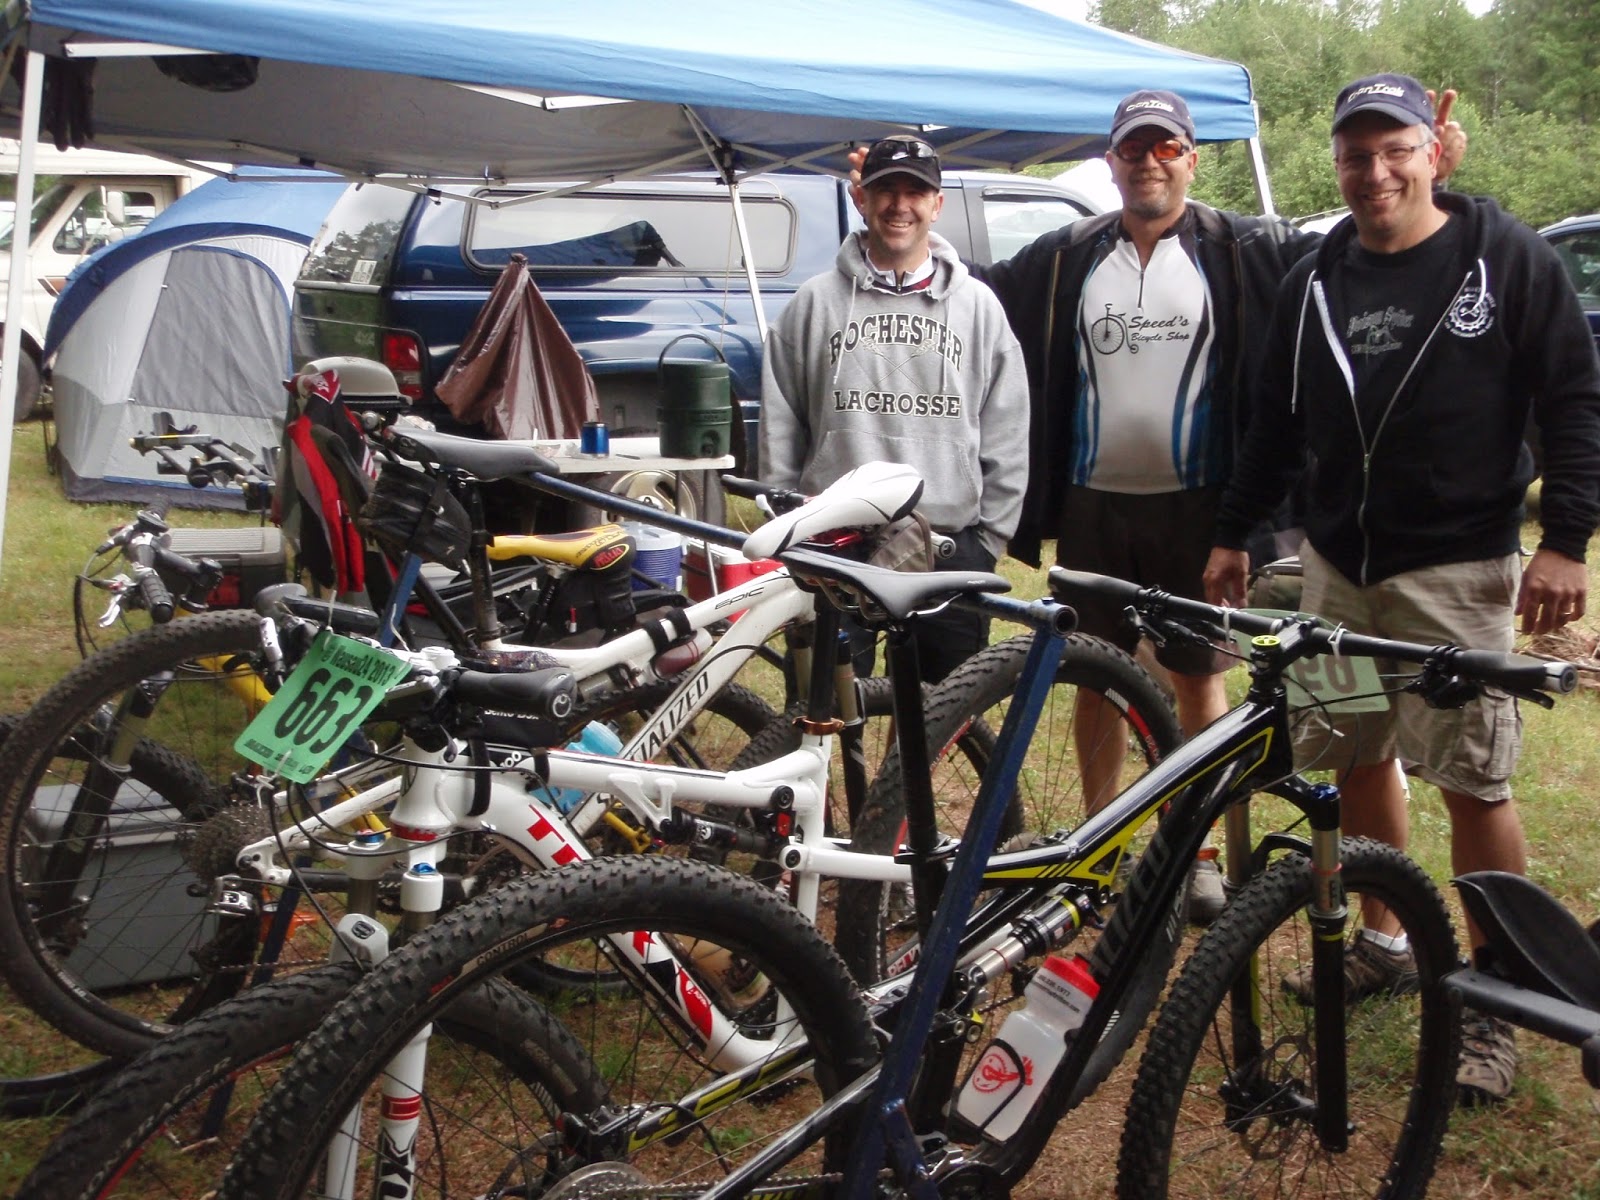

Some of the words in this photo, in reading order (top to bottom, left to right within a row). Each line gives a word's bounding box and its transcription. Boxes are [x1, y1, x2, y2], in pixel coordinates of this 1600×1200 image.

[1128, 316, 1190, 331] Speed's
[1131, 332, 1162, 343] Bicycle
[1165, 331, 1190, 342] Shop
[829, 313, 964, 372] ROCHESTER
[833, 390, 961, 419] LACROSSE
[274, 667, 373, 754] 663
